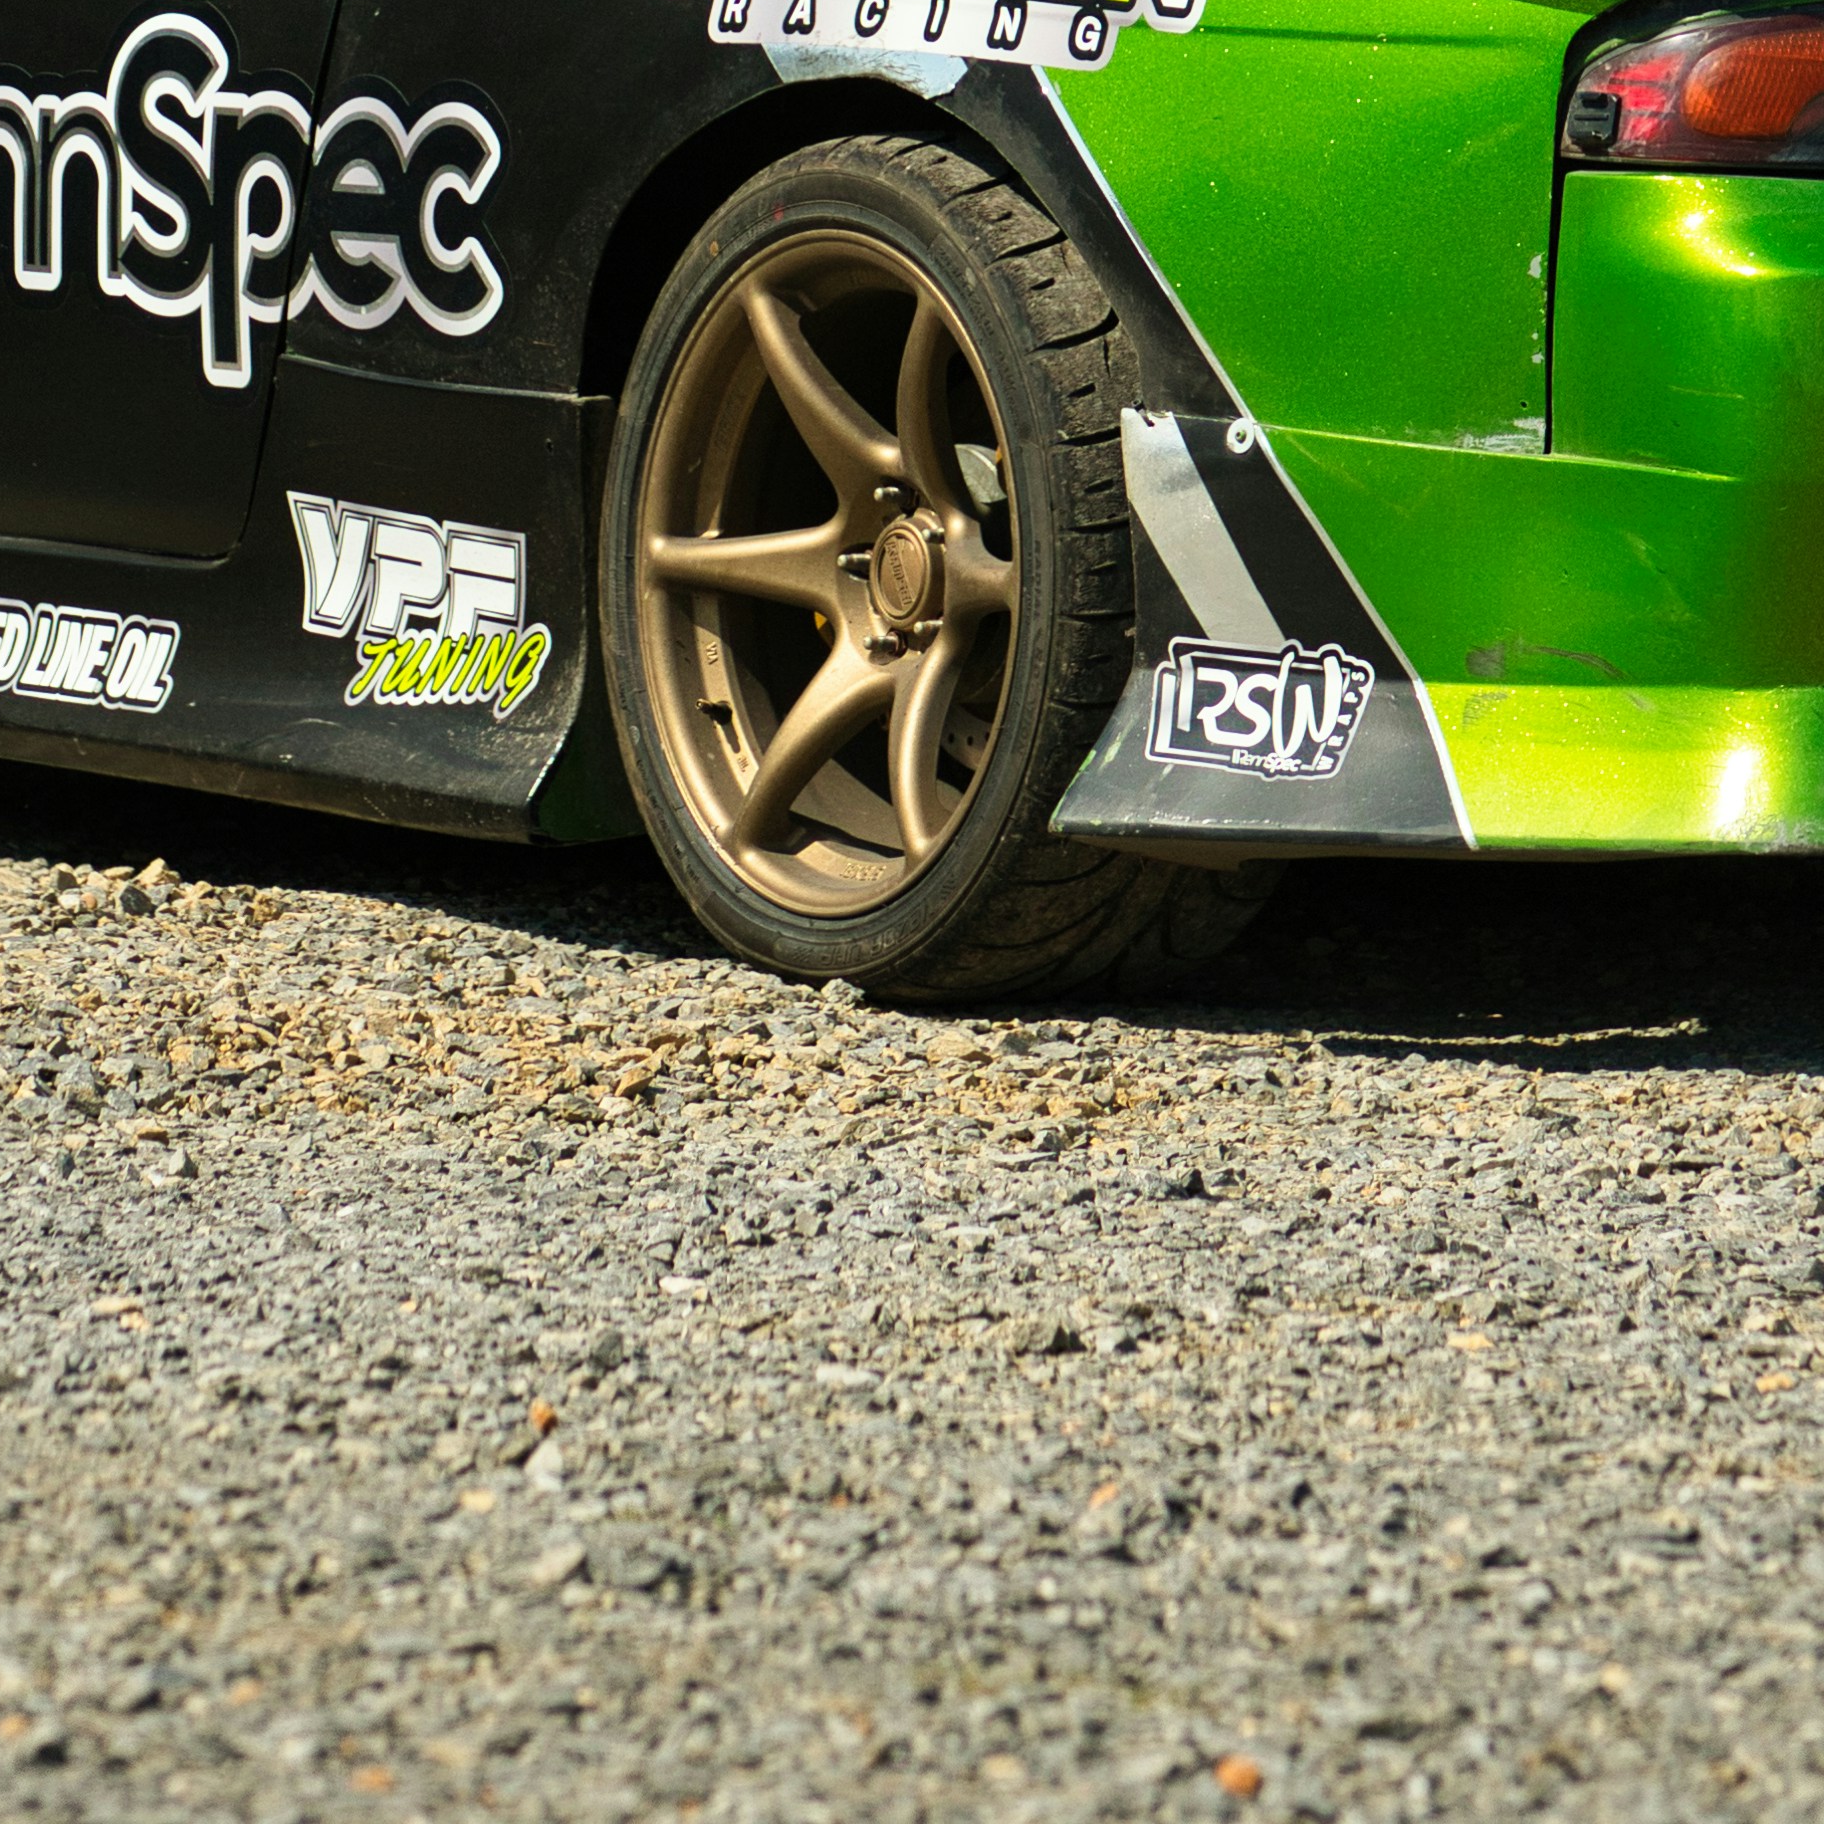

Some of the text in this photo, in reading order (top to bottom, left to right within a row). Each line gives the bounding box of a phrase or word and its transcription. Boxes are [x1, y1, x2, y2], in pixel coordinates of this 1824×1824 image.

[105, 626, 175, 703] OIL
[349, 629, 547, 710] TUNING
[1315, 670, 1366, 771] WRAPS
